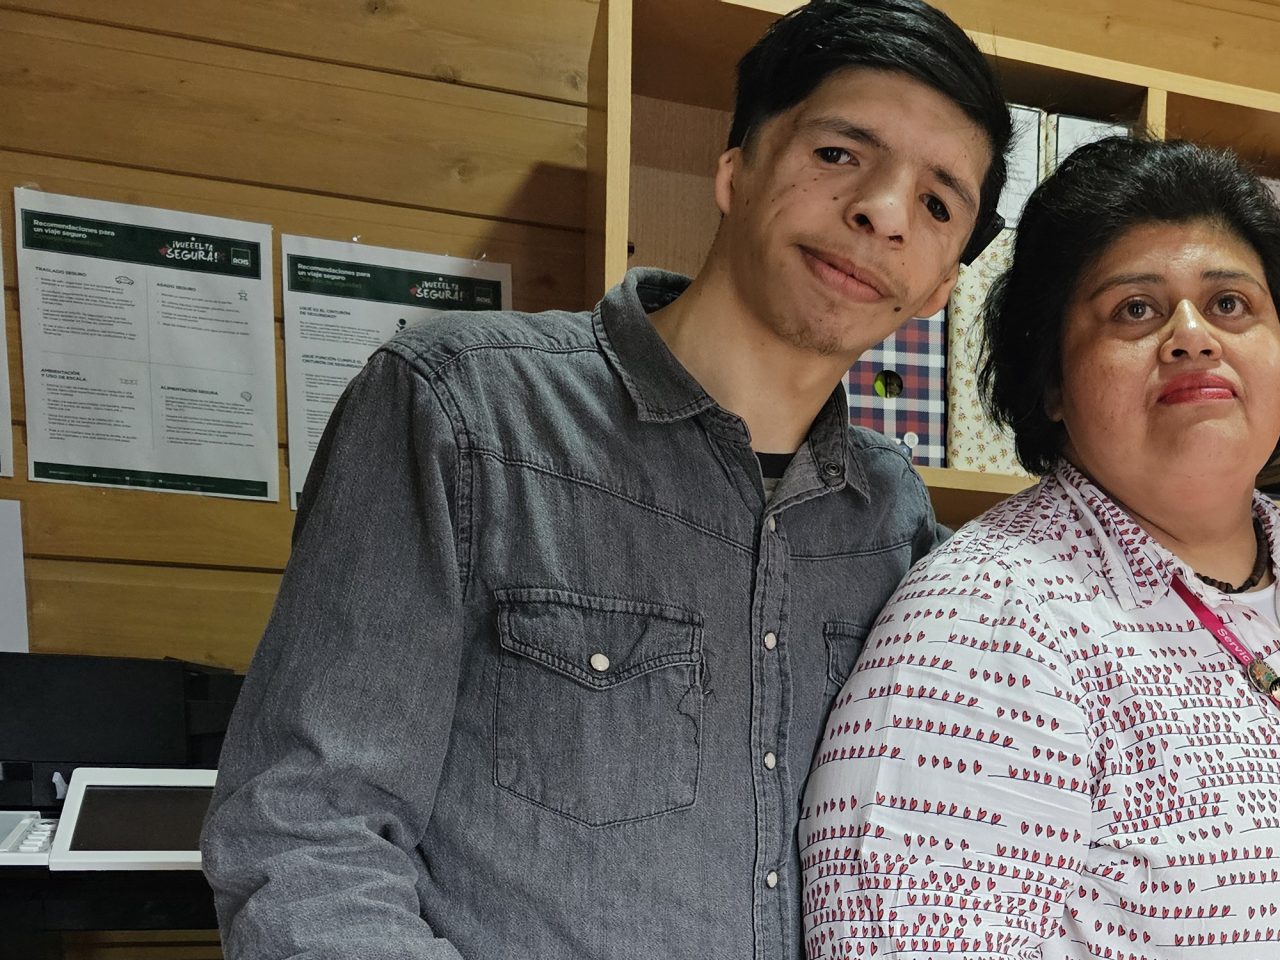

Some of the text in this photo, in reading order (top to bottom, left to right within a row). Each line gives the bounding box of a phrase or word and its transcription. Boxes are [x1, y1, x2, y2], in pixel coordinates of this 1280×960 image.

[33, 219, 116, 237] Recomendaciones para
[44, 228, 61, 236] viaje
[62, 231, 87, 239] seguro
[165, 248, 218, 263] SEGURA!
[297, 263, 355, 276] Recomendaciones
[323, 273, 346, 281] seguro
